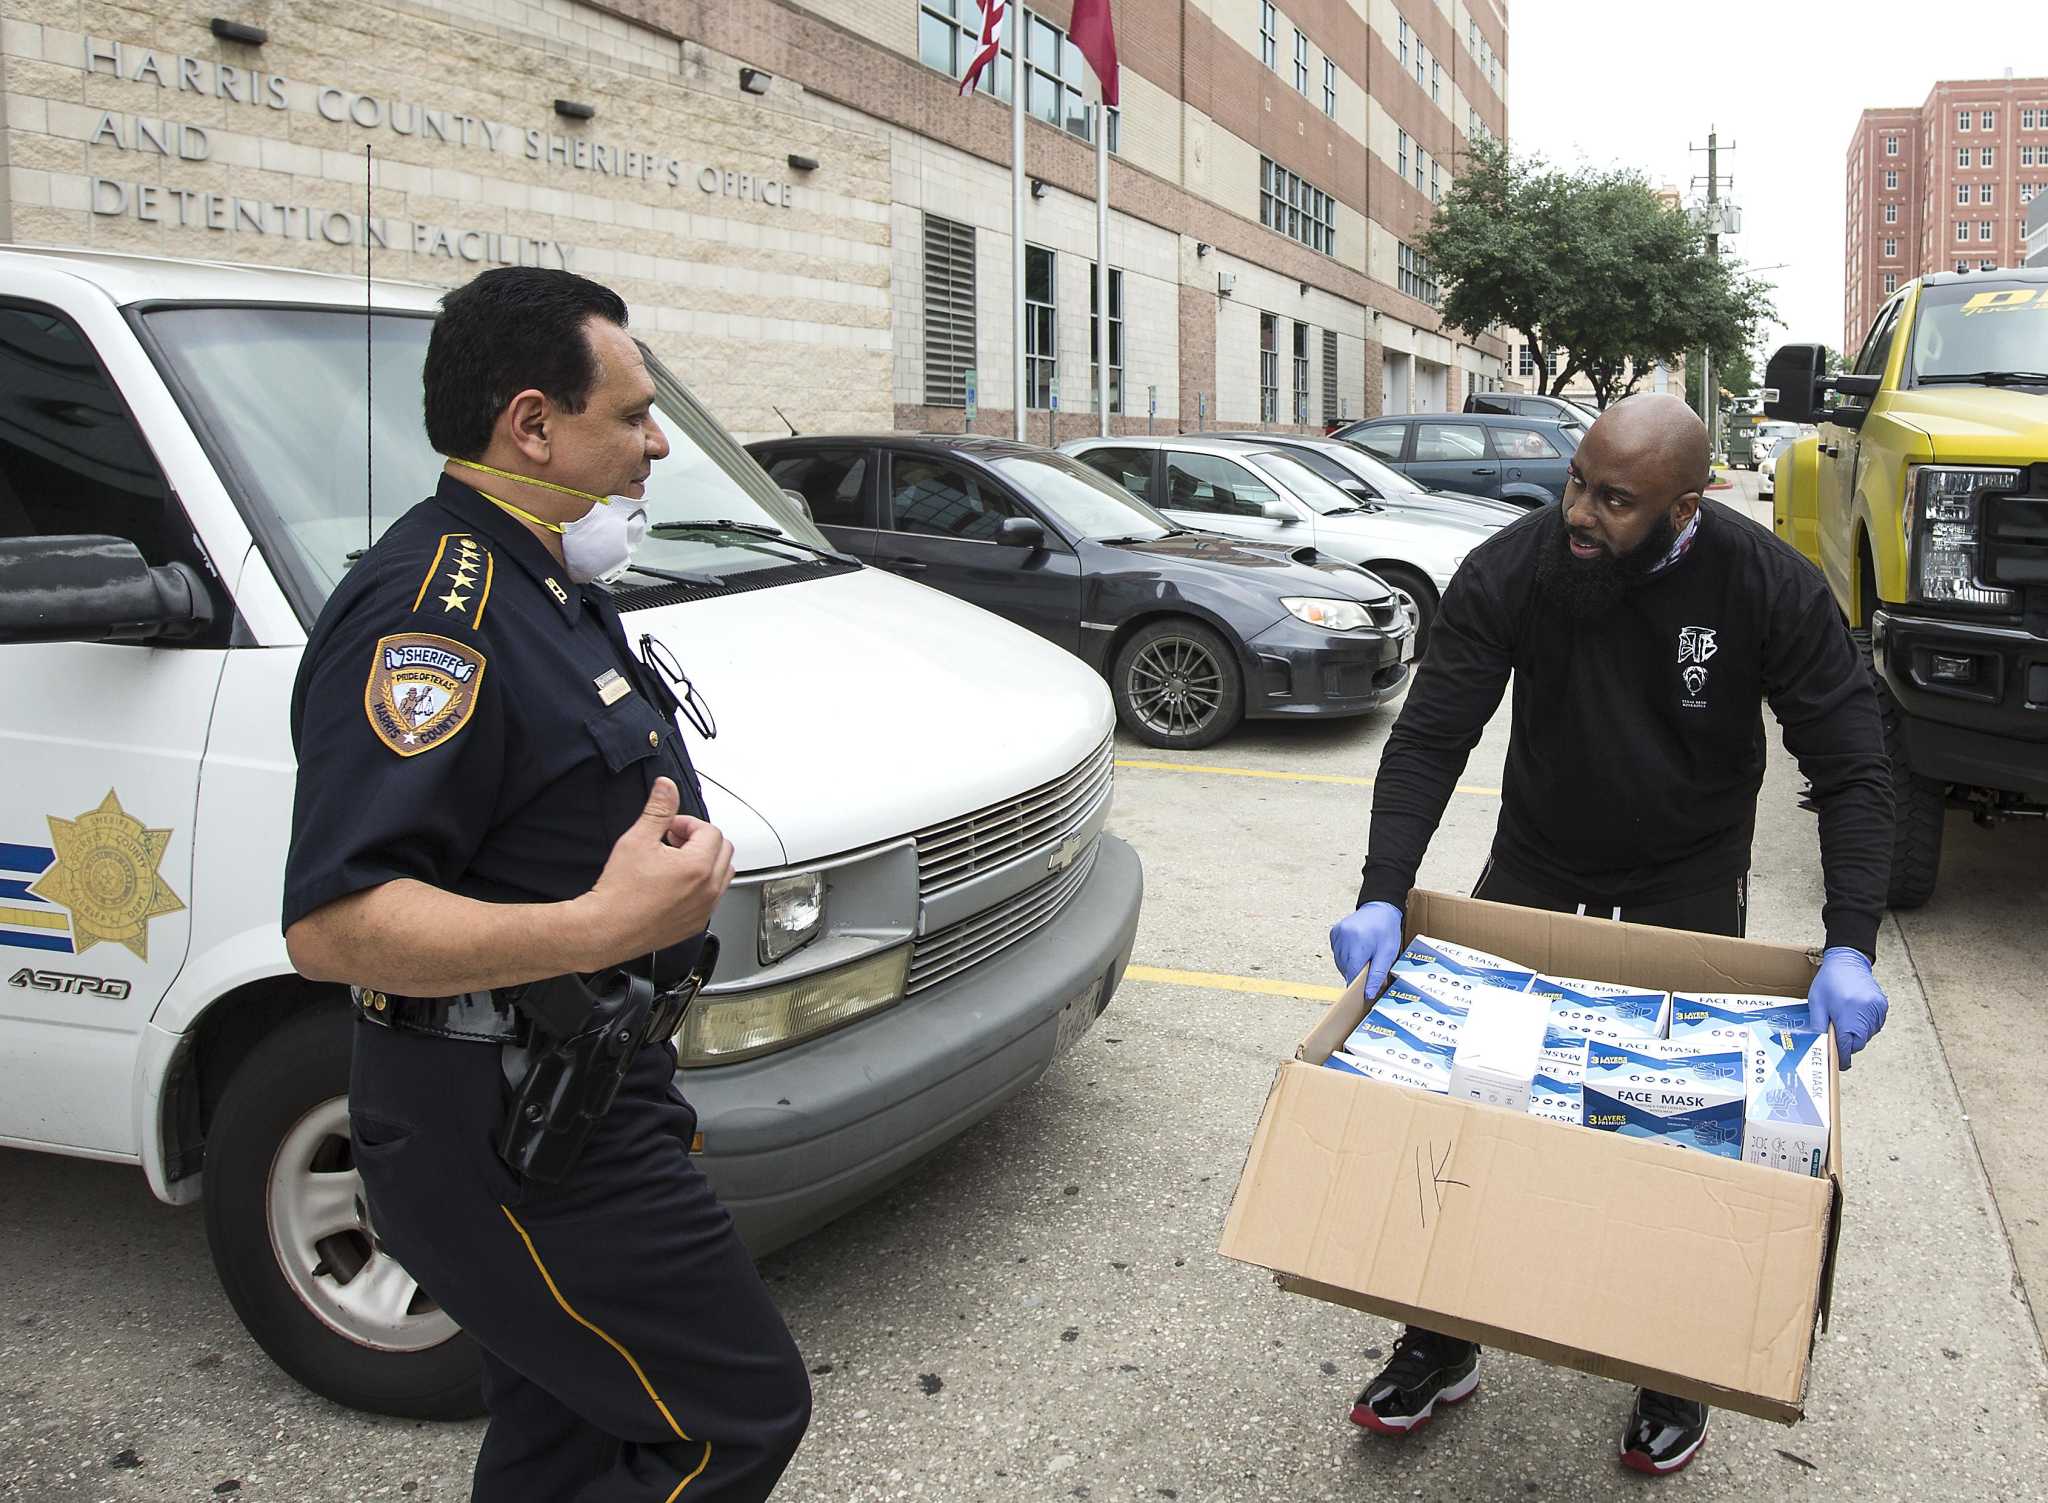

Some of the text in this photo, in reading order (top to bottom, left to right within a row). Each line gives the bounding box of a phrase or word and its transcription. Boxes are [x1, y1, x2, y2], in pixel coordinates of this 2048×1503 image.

[84, 34, 793, 208] HARRIS COUNTY SHERIFF'S OFFICE
[90, 110, 209, 161] AND
[91, 176, 574, 270] DETENTION FACILITY
[405, 649, 456, 671] SHERIFF
[396, 672, 455, 690] PRIDE OF TEXAS
[374, 702, 401, 739] HARRIS
[420, 710, 462, 744] COUNTY
[115, 834, 147, 868] COUNTY
[1436, 945, 1502, 969] FACE MASK
[8, 967, 132, 1000] ASTRO
[1560, 981, 1631, 995] FACE MASK
[1737, 999, 1775, 1007] MASK
[1430, 1030, 1458, 1044] MAS
[1618, 1042, 1702, 1055] FACE MASK
[1391, 1073, 1431, 1089] MASK
[1812, 1047, 1824, 1099] FACE MASK
[1617, 1090, 1705, 1108] FACE MASK
[1588, 1114, 1627, 1125] 3 LAYERS
